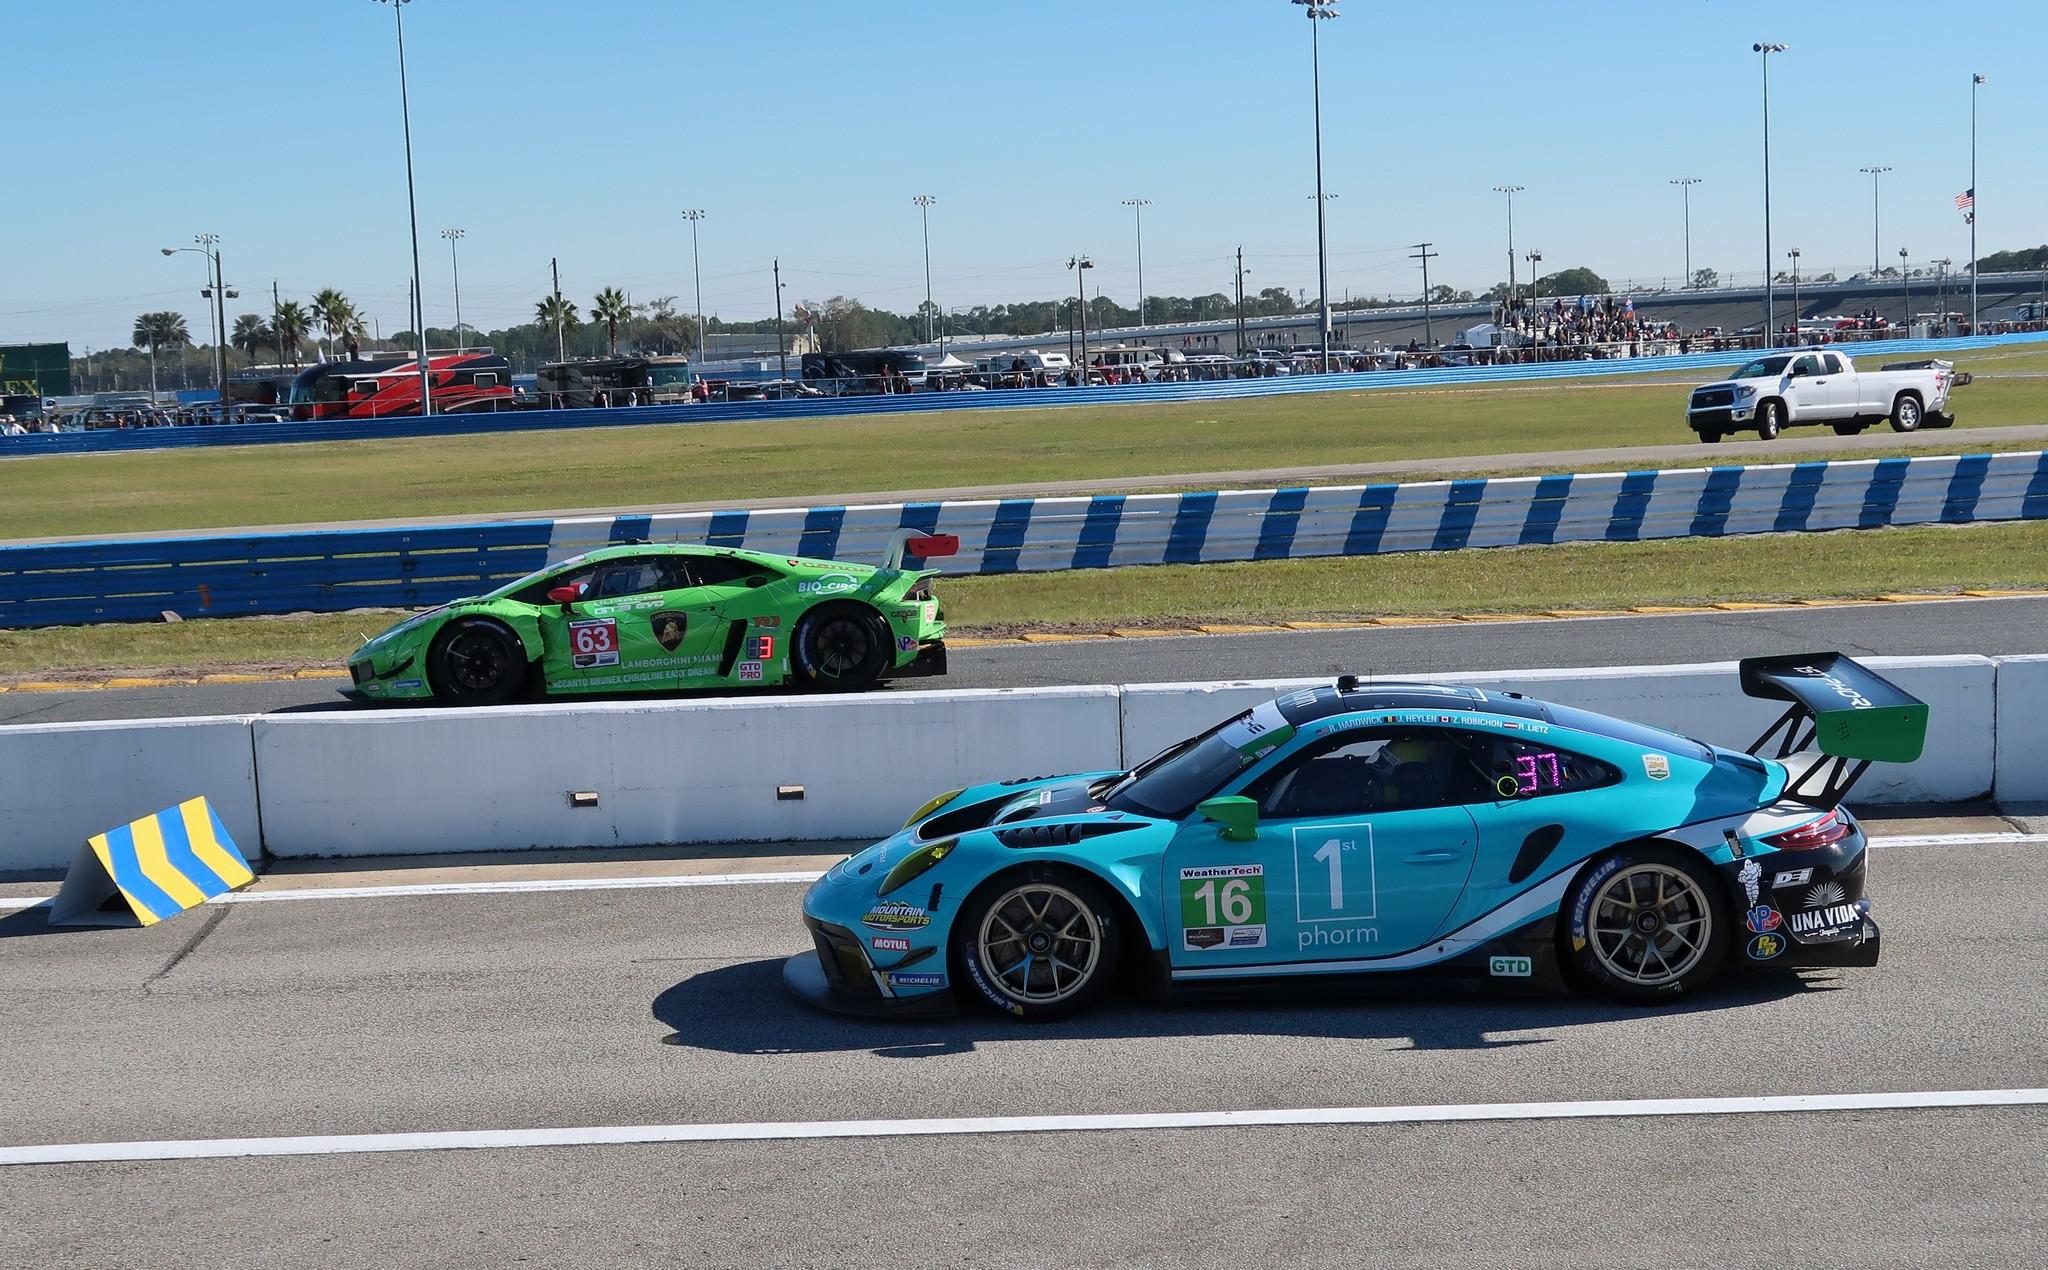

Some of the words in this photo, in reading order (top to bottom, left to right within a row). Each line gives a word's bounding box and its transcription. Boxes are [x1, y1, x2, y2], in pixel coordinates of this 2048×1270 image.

[577, 627, 611, 652] 63
[622, 656, 691, 669] LAMBORGHINI
[693, 654, 724, 664] MIAMI
[740, 663, 761, 671] GTD
[740, 671, 761, 679] PRO
[1339, 716, 1383, 730] HARDWICK
[1406, 714, 1438, 723] HEYLEN
[1461, 717, 1503, 728] ROBICHON
[1528, 724, 1549, 734] LIETZ
[1516, 753, 1560, 792] 37
[1183, 866, 1261, 878] WeatherTech
[1575, 859, 1617, 924] MICHELIN
[1194, 879, 1252, 925] 16
[870, 905, 926, 917] MOUNTAIN
[862, 913, 931, 925] MOTORSPORTS
[1746, 905, 1772, 932] VP
[1791, 908, 1825, 933] UNA
[1824, 903, 1861, 927] VIDA
[874, 938, 908, 950] MOTUL
[1299, 925, 1379, 951] phorm
[1491, 959, 1530, 973] GTD
[898, 976, 940, 985] MICHELIN
